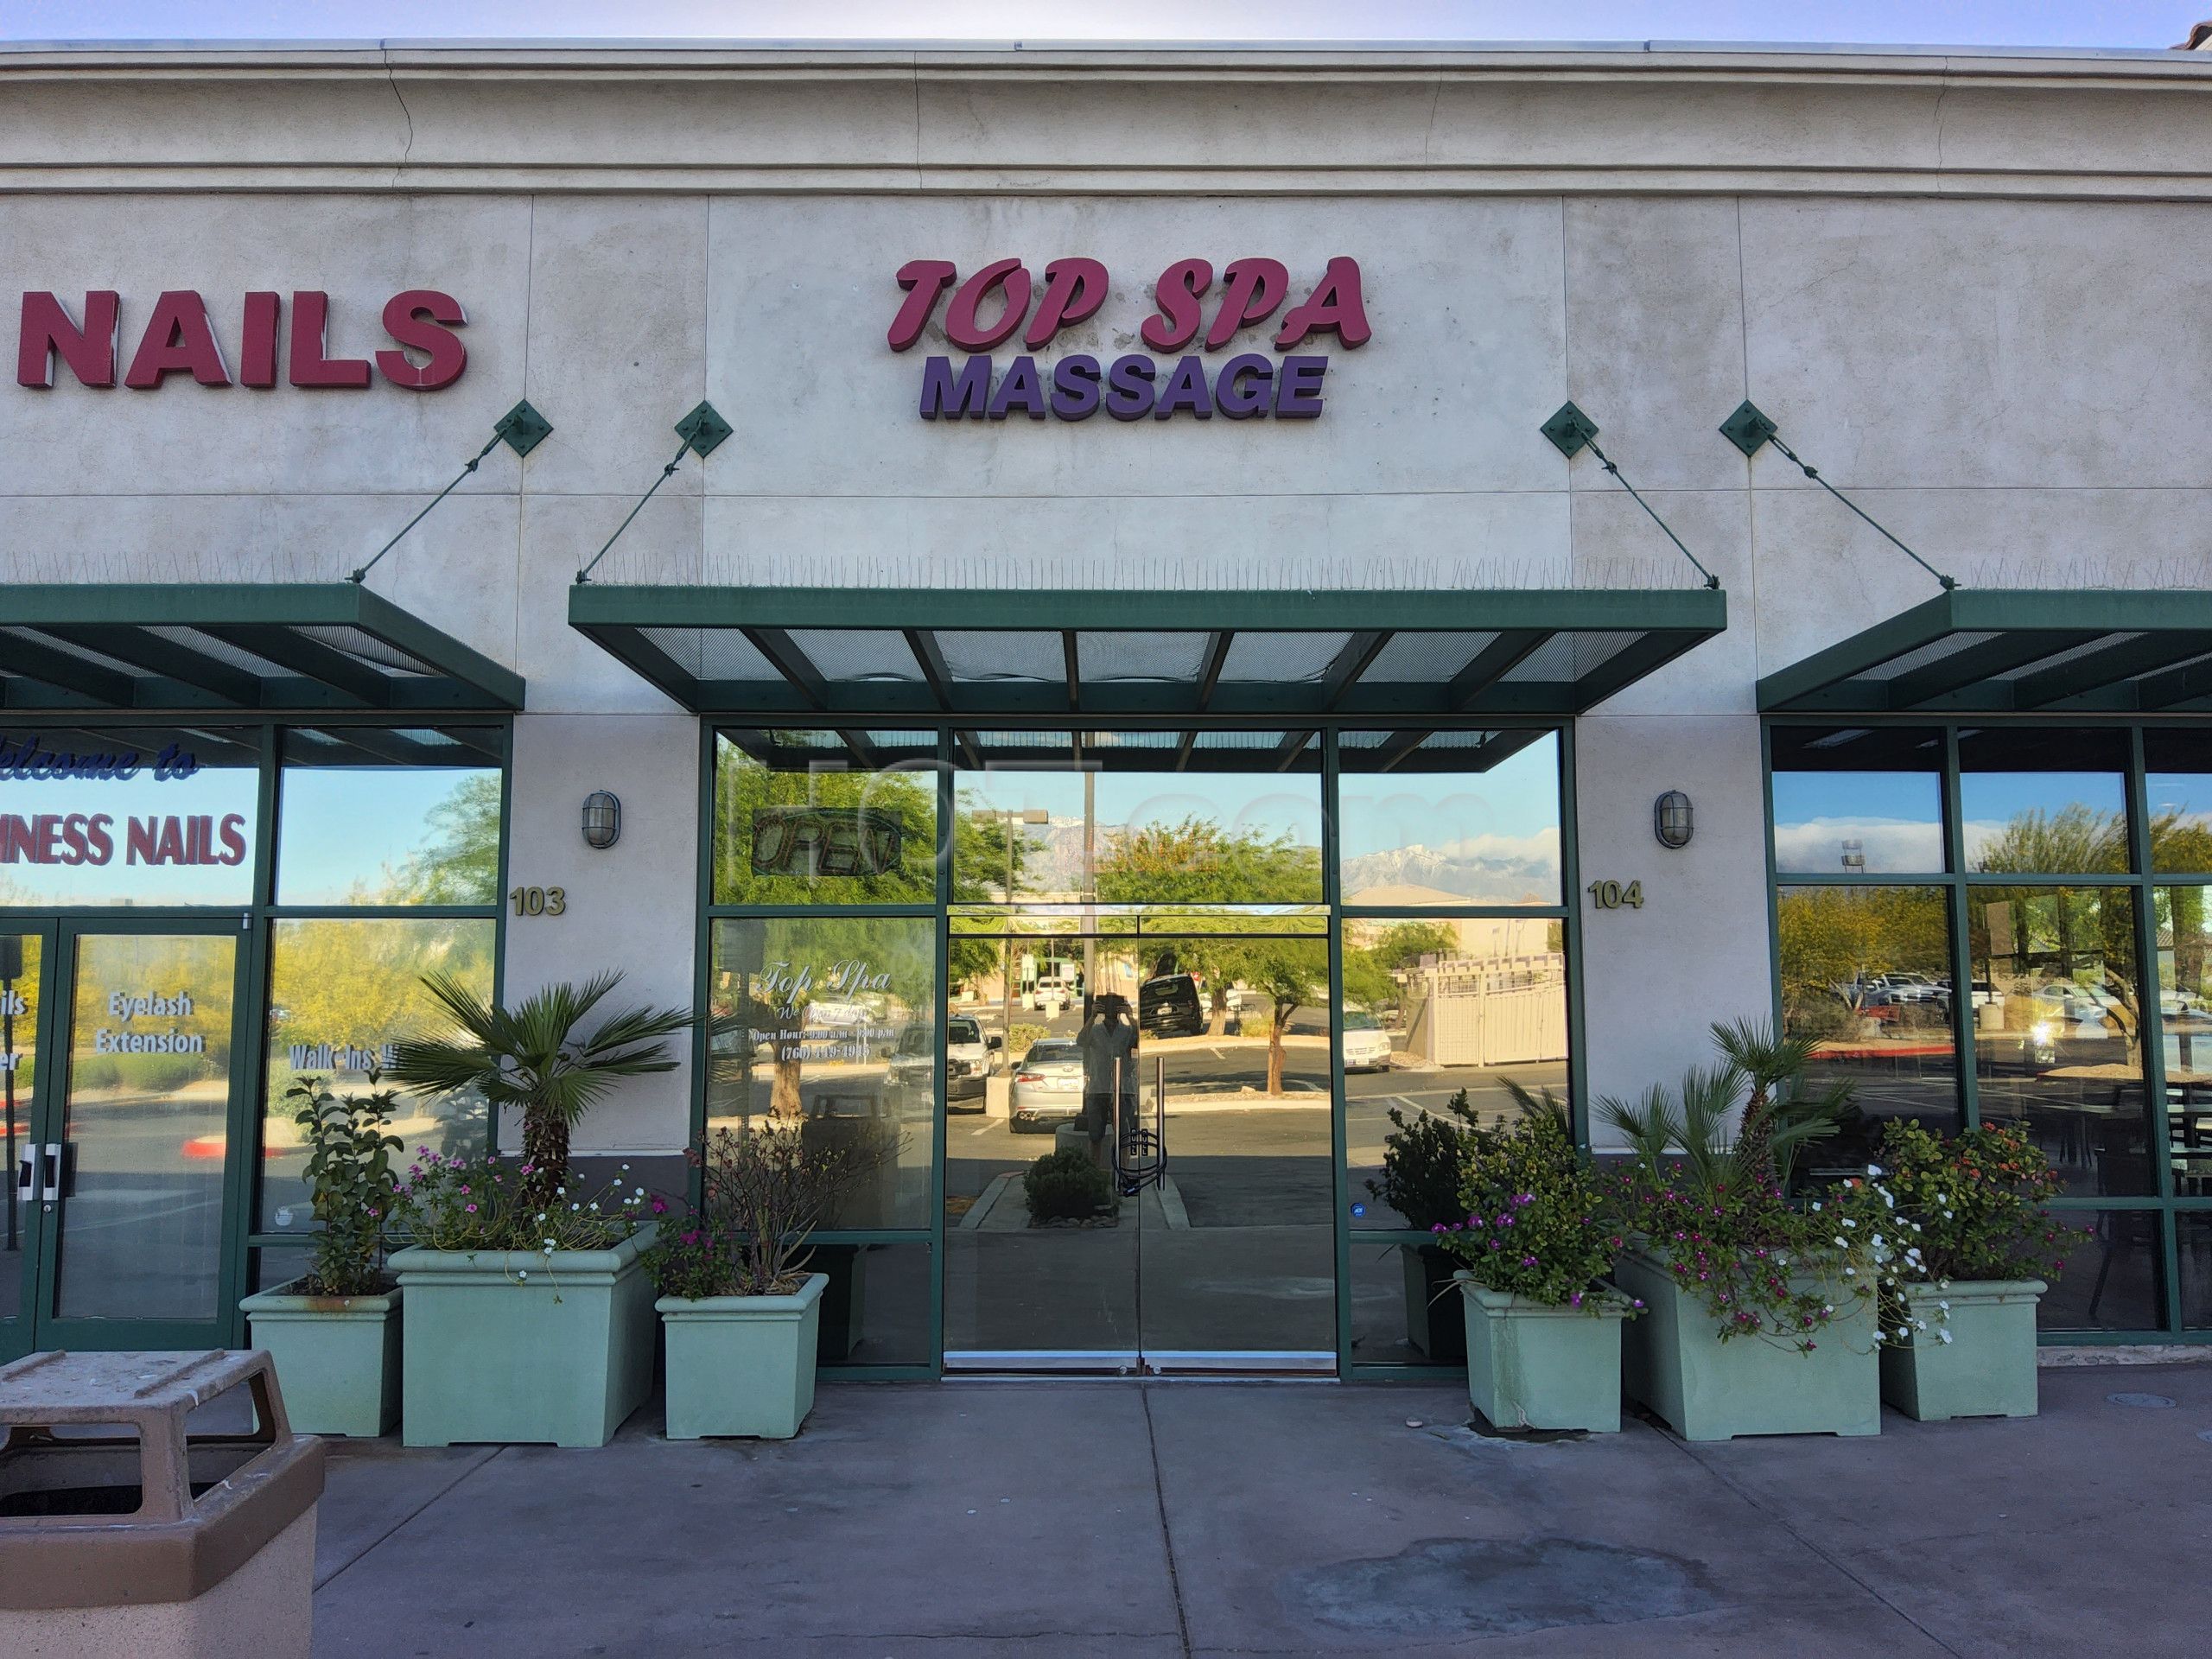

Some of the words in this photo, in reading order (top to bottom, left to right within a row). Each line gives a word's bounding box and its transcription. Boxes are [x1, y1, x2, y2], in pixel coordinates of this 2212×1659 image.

[887, 257, 1109, 353] TOP
[1141, 256, 1372, 353] SPA
[16, 289, 468, 391] NAILS
[919, 353, 1329, 421] MASSAGE
[0, 734, 141, 781] elcome
[153, 742, 200, 782] to
[126, 813, 247, 866] NAILS
[752, 814, 896, 875] OPEN
[510, 886, 567, 916] 103
[1587, 880, 1644, 909] 104
[756, 961, 812, 1004] Top
[827, 959, 891, 1001] Spa
[108, 990, 194, 1022] Eyelash
[777, 1007, 800, 1020] We
[95, 1027, 204, 1053] Extension
[753, 1030, 777, 1042] Open
[289, 1045, 373, 1071] Walk-Ins
[781, 1046, 812, 1062] (760)
